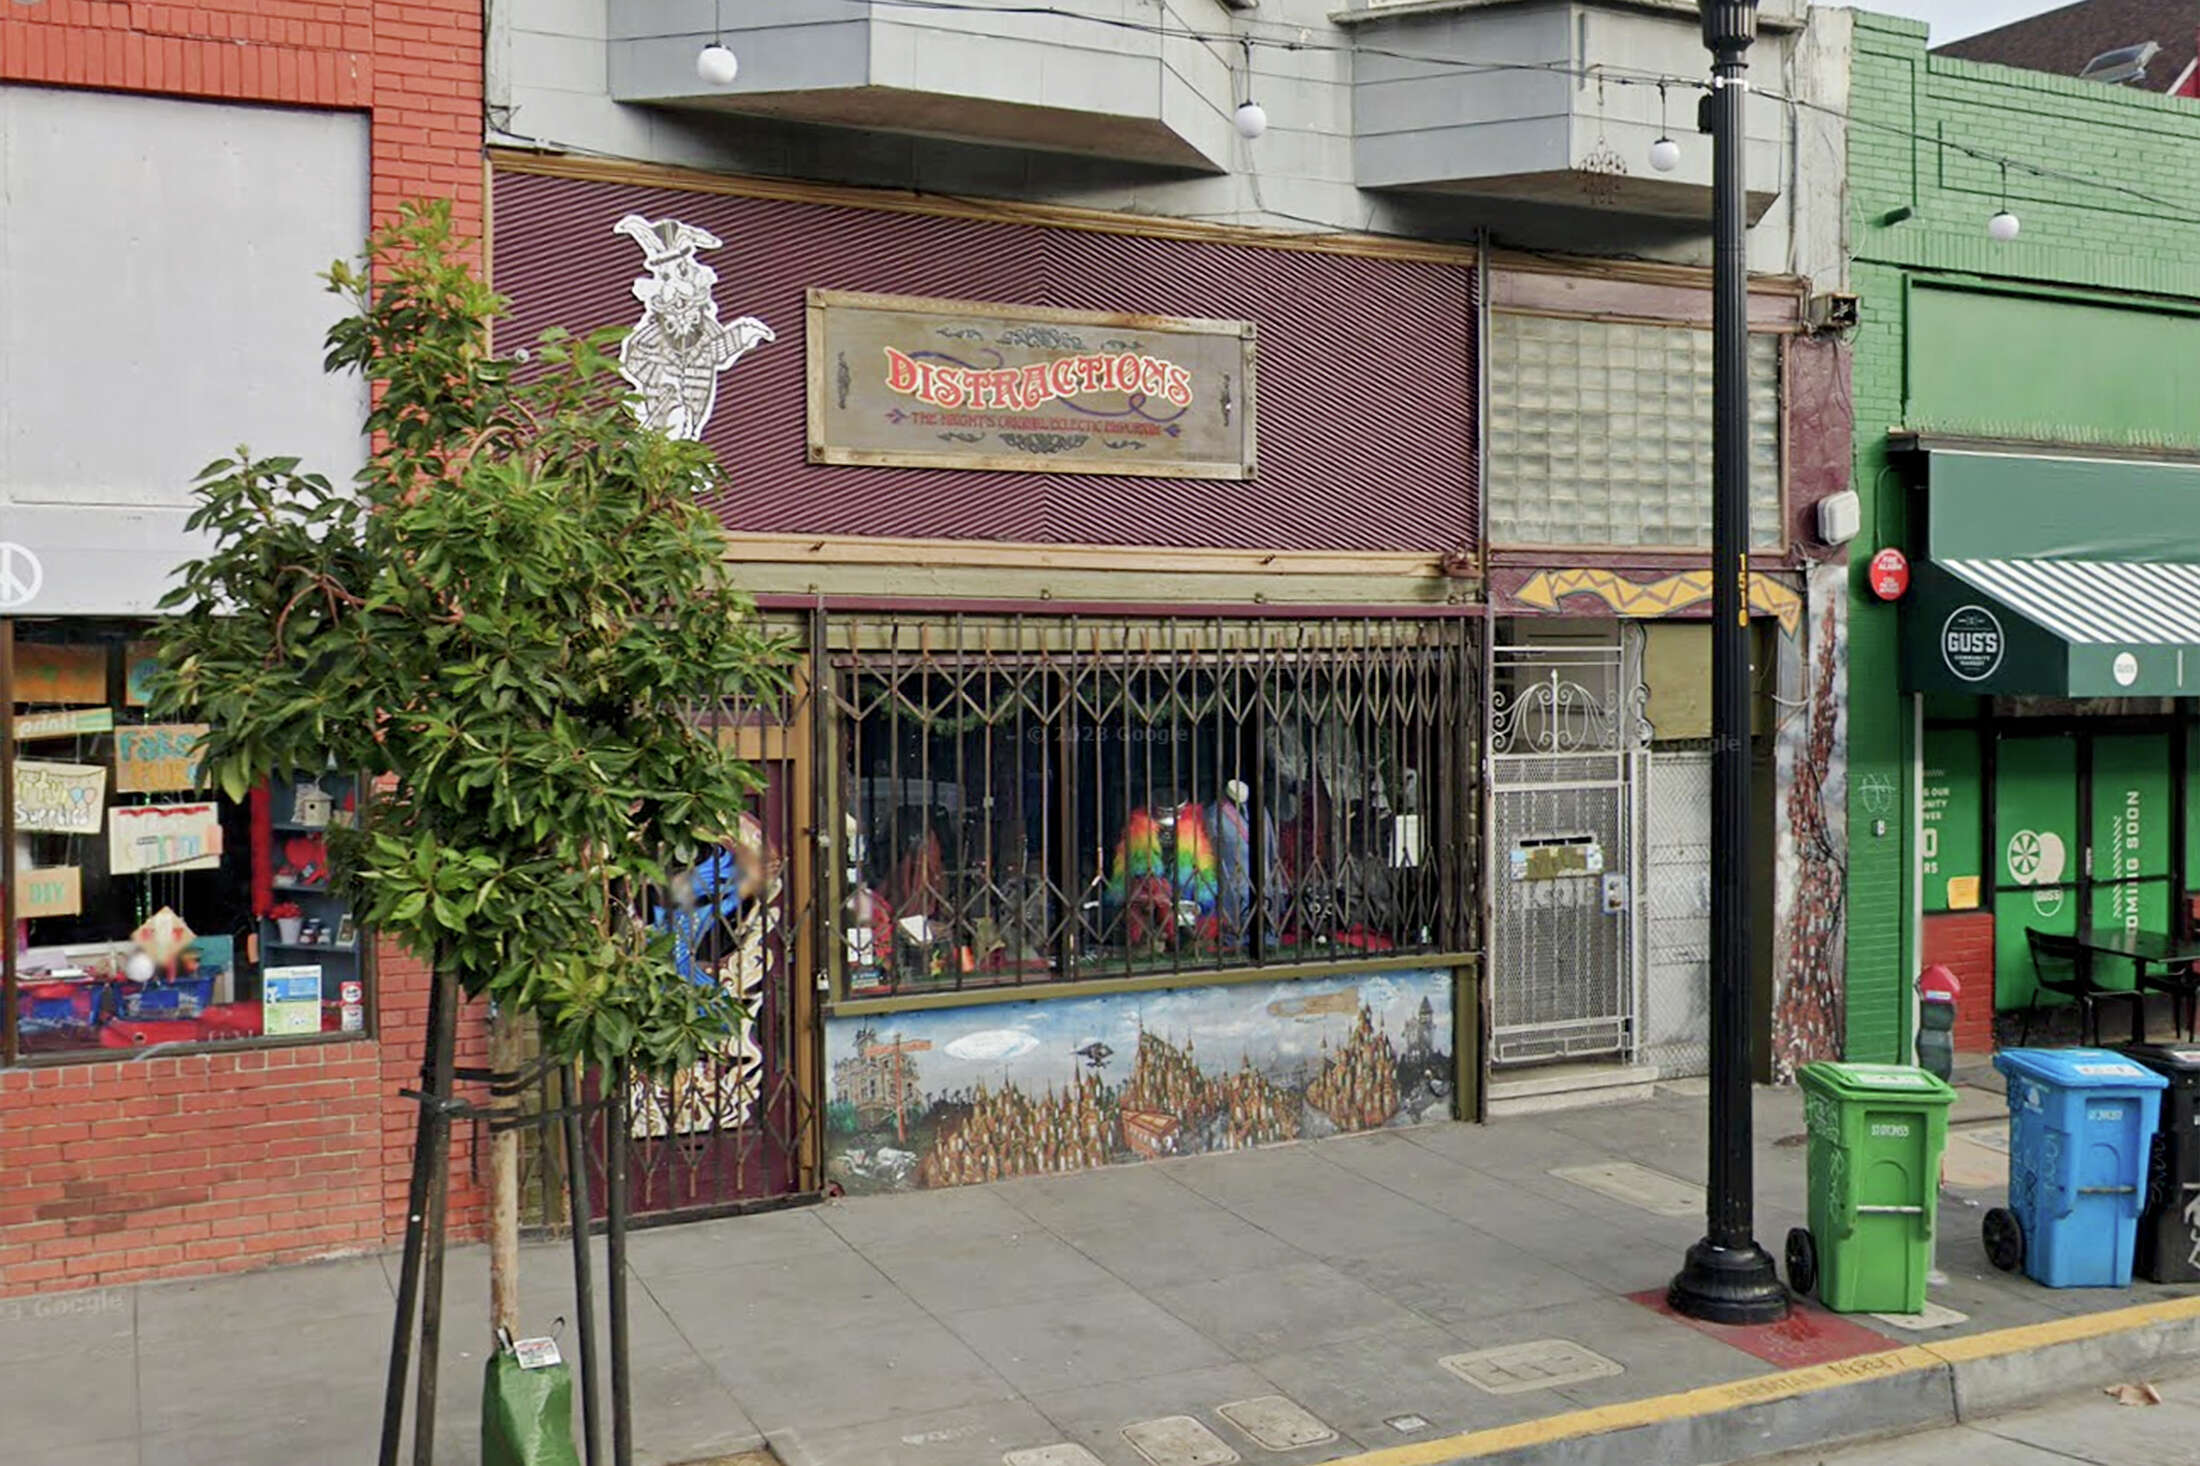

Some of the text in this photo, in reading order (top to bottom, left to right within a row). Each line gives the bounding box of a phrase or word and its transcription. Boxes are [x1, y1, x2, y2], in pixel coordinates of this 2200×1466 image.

[884, 347, 1193, 411] DISTRACTIONS
[911, 411, 938, 426] THE
[2126, 790, 2139, 931] OMING SOON
